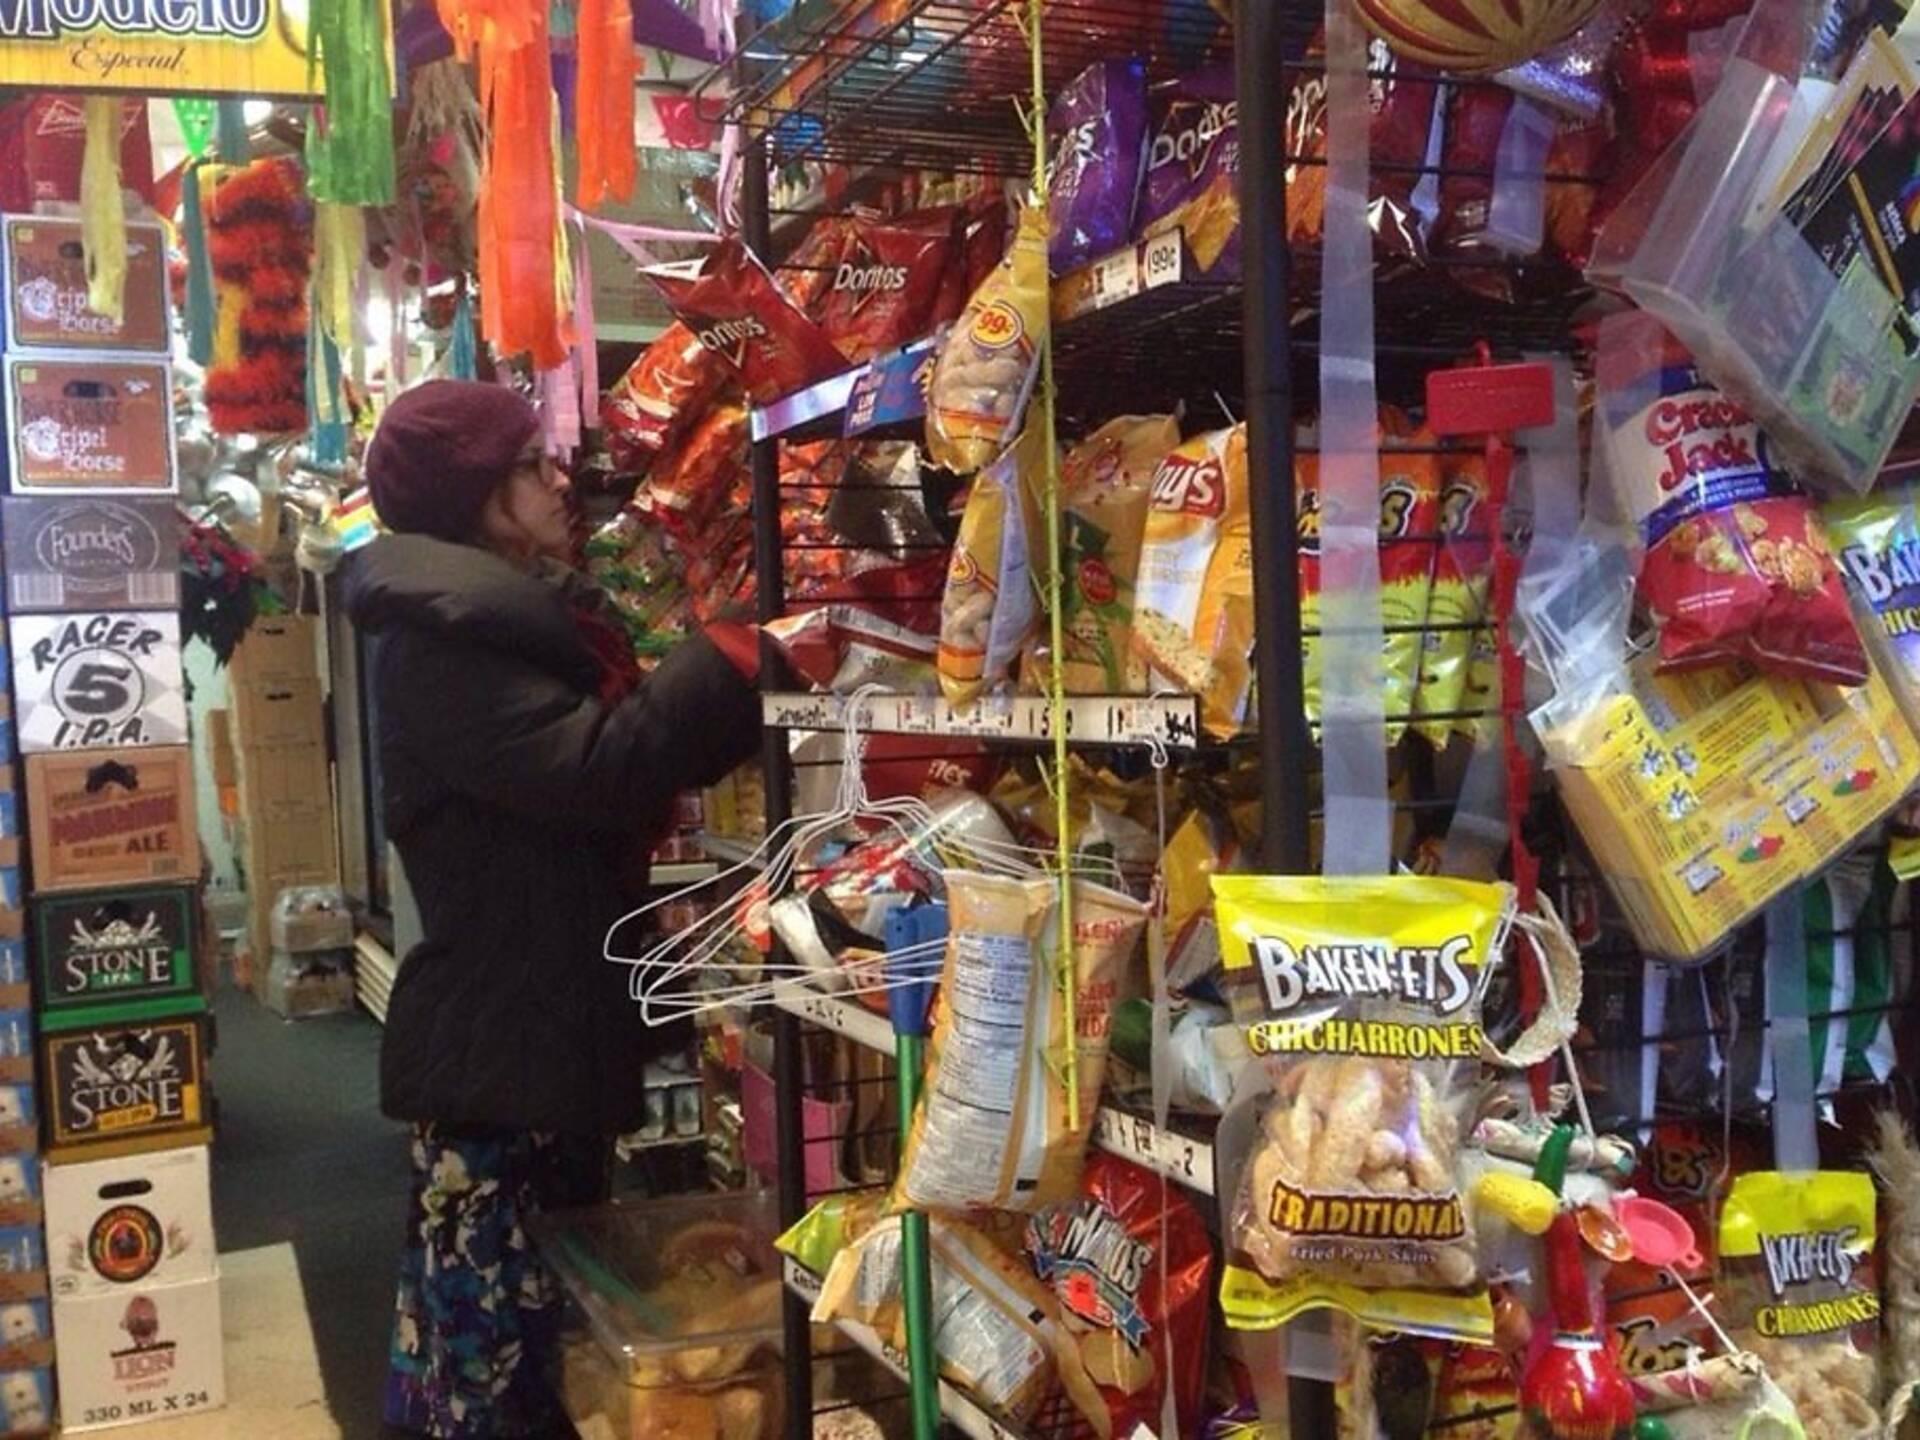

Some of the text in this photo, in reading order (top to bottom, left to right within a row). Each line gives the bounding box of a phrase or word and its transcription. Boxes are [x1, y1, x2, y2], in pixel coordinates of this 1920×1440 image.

[833, 263, 908, 291] Doritos
[31, 617, 162, 671] RACER
[65, 664, 132, 714] 5
[53, 718, 150, 747] I.P.A.
[126, 831, 169, 854] ALE
[66, 946, 170, 993] STONE
[1253, 934, 1472, 1013] BAKEN-ETS
[1248, 1018, 1481, 1058] CHICHARRONES
[71, 1076, 181, 1129] STONE
[1271, 1181, 1464, 1239] TRADITIONAL
[83, 1391, 209, 1423] 330 ML X 24
